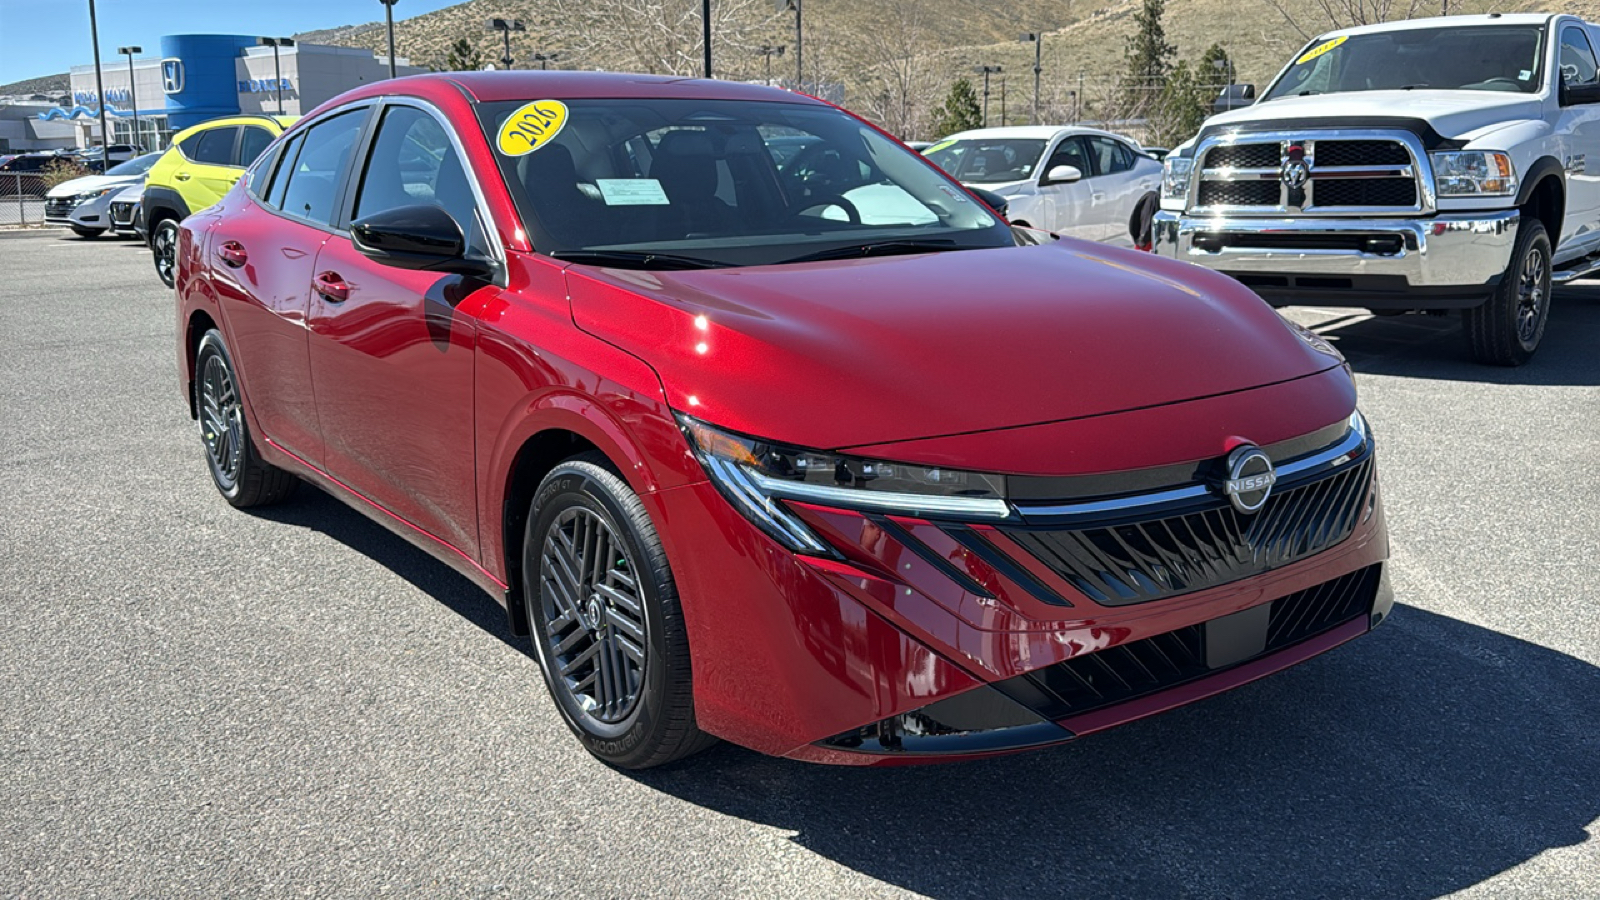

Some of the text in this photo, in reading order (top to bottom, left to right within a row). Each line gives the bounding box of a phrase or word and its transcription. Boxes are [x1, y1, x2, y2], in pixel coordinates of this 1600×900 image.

[509, 105, 558, 146] 2026
[561, 479, 571, 490] GT
[1229, 473, 1276, 491] NISSAN
